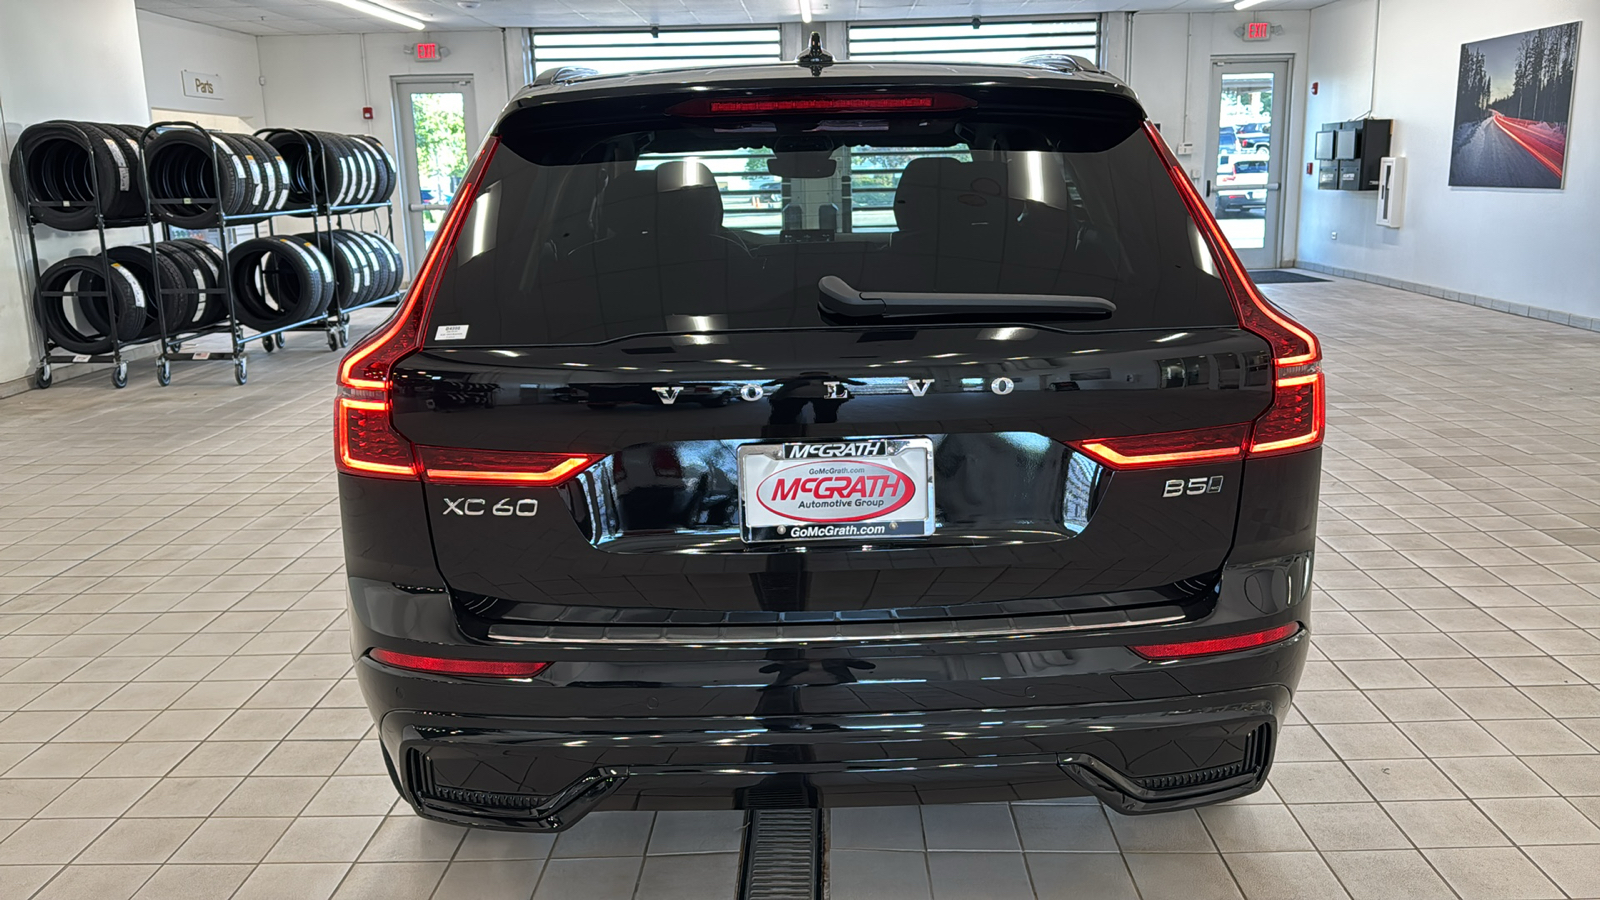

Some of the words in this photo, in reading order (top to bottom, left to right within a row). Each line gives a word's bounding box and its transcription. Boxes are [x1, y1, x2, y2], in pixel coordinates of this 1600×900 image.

[1249, 22, 1268, 38] EXIT
[417, 43, 435, 59] EXIT
[195, 78, 214, 94] Parts
[652, 377, 1014, 405] VOLVO
[809, 467, 865, 475] GoMcGrath.com
[1162, 477, 1208, 498] B5
[798, 499, 852, 509] Automotive
[854, 498, 884, 508] Group
[790, 525, 885, 538] GoMcGrath.com
